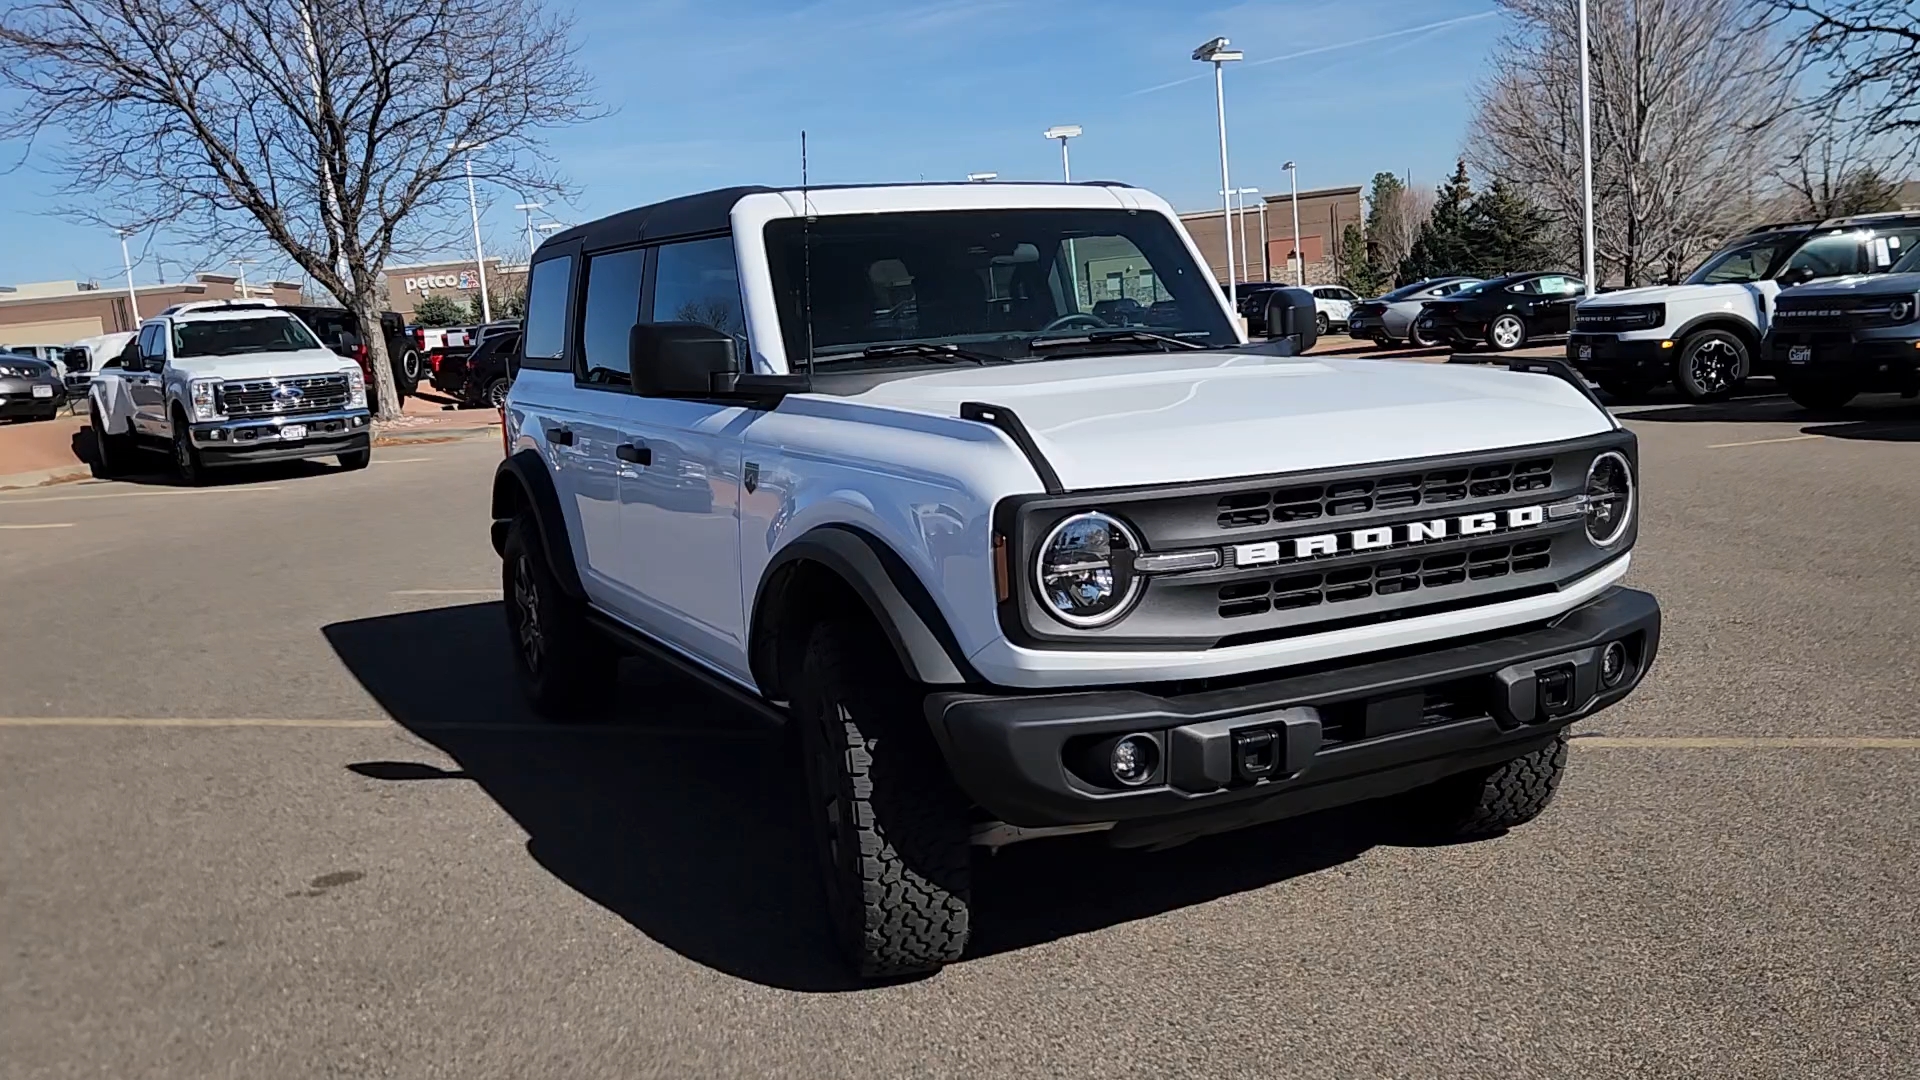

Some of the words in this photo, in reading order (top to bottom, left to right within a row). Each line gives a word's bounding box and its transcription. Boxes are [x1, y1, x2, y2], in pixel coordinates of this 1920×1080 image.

[405, 274, 457, 294] petco
[1779, 309, 1841, 317] BRONCO
[1233, 505, 1544, 566] BRONCO
